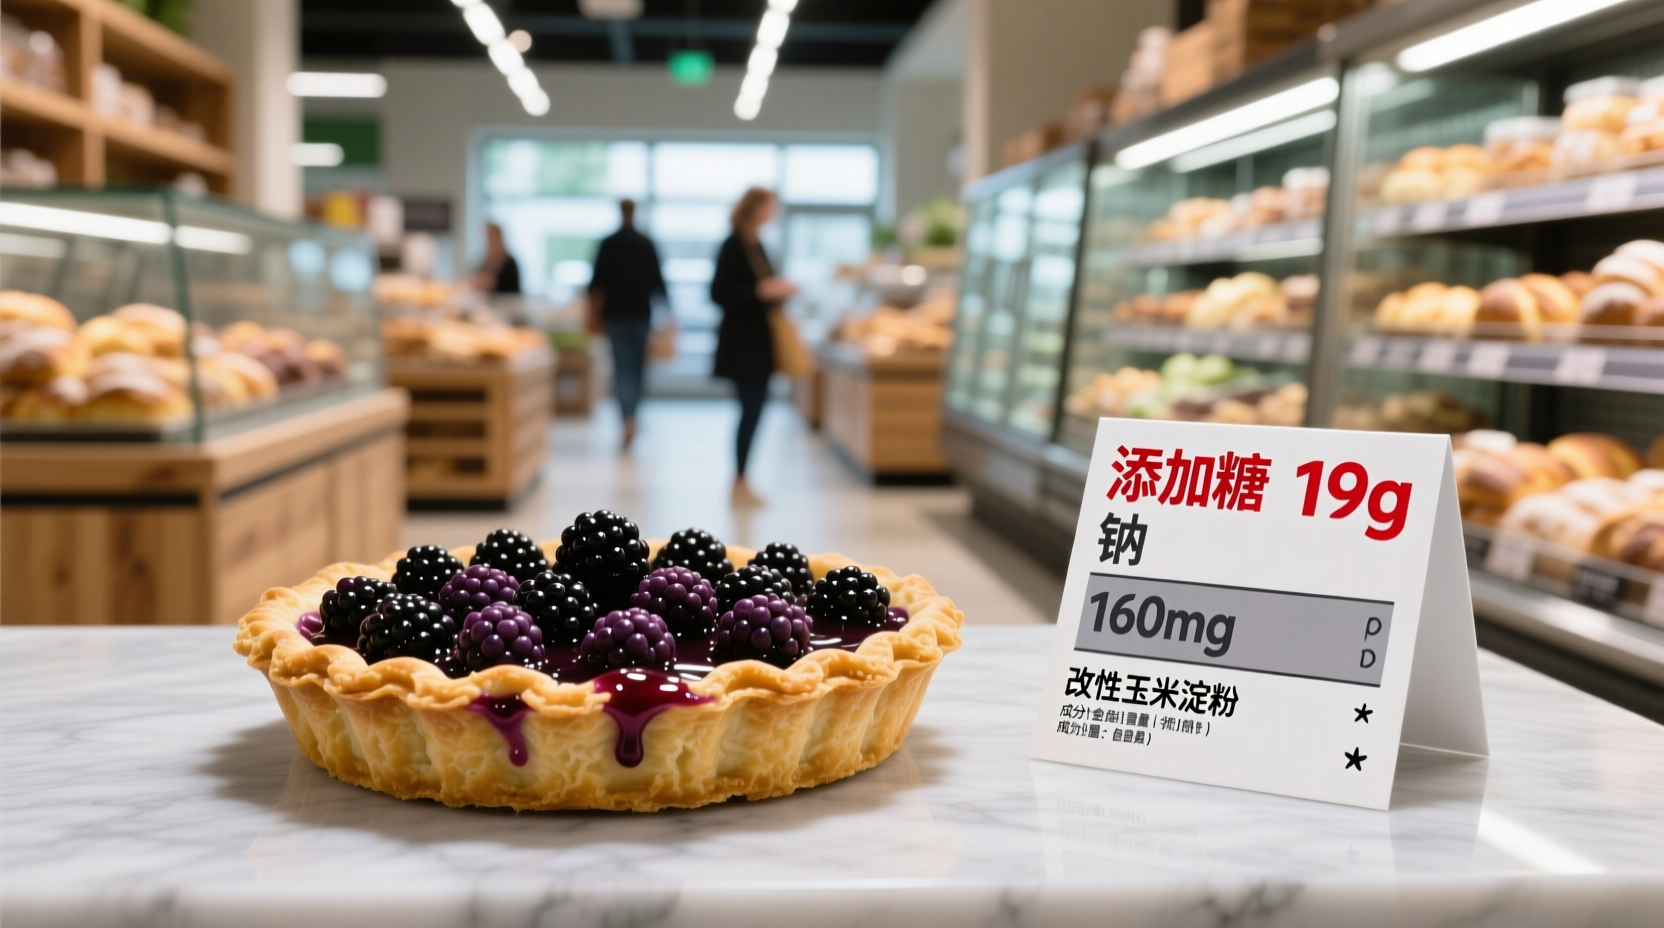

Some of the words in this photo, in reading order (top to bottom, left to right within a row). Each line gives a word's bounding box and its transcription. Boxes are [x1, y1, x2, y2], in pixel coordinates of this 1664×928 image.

[1105, 445, 1272, 512] 添加糖
[1295, 460, 1413, 541] 19g
[1097, 512, 1147, 566] 钠
[1088, 591, 1237, 657] 160mg
[1064, 666, 1239, 718] 改性玉米淀粉
